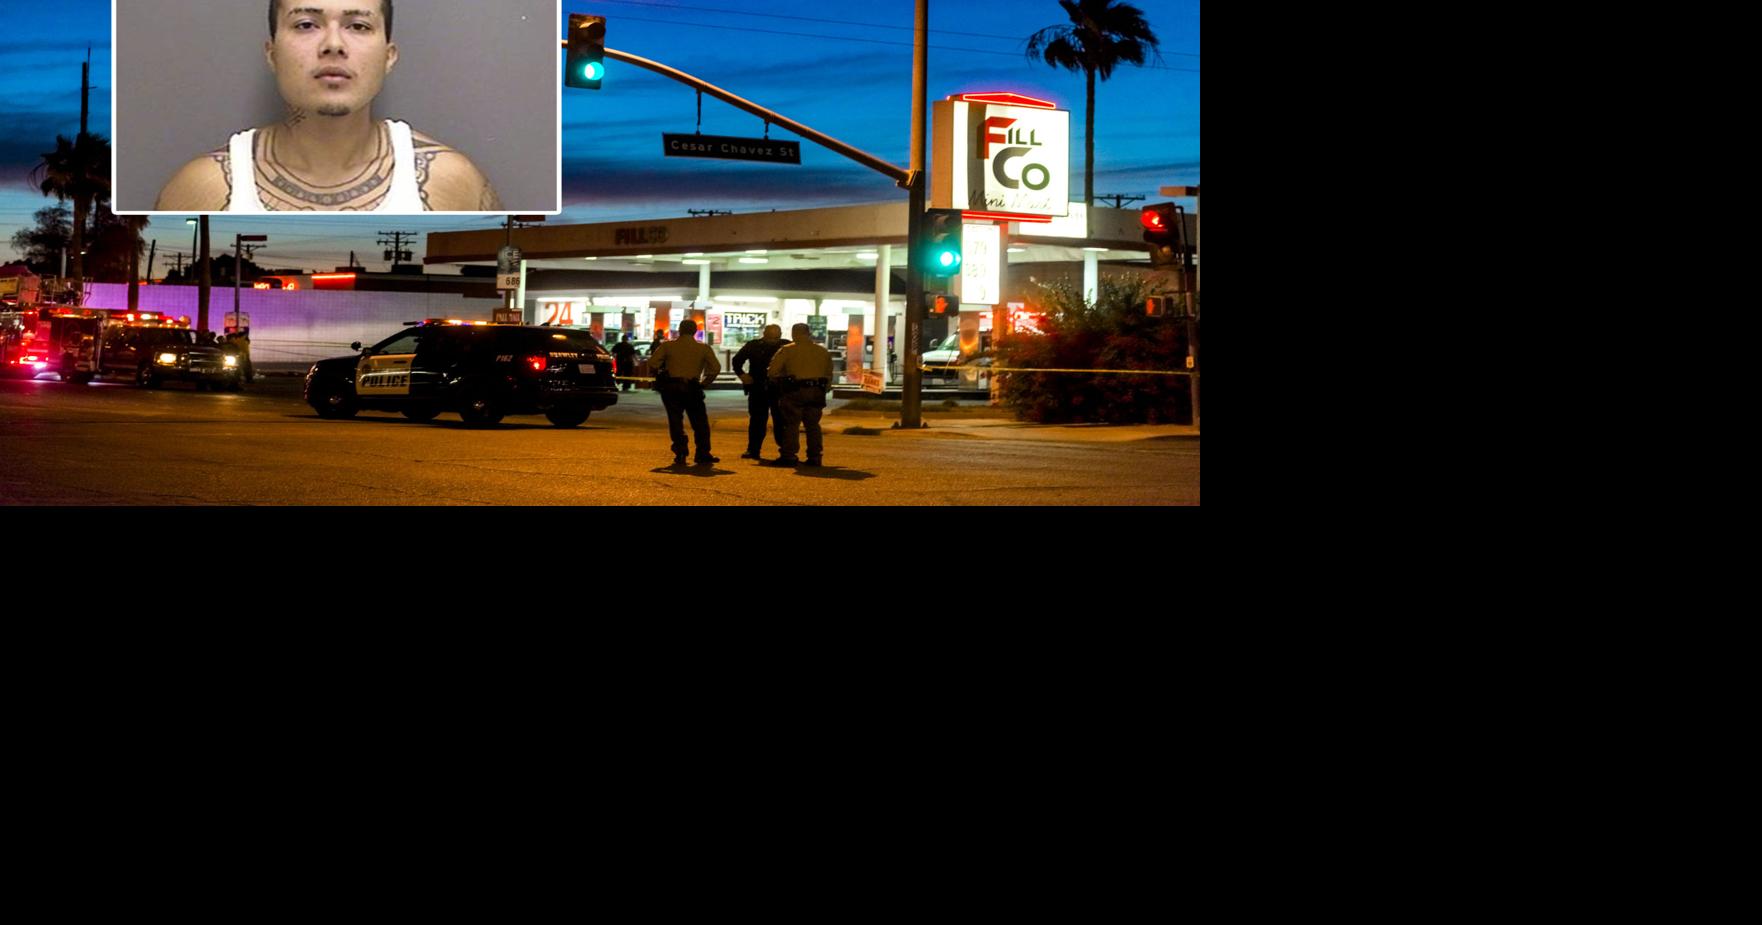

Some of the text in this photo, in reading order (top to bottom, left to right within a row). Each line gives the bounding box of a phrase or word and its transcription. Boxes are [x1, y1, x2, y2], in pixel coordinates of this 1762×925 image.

[671, 140, 795, 157] Cesar Chavez St
[544, 302, 573, 325] 24
[362, 374, 408, 387] POLICE
